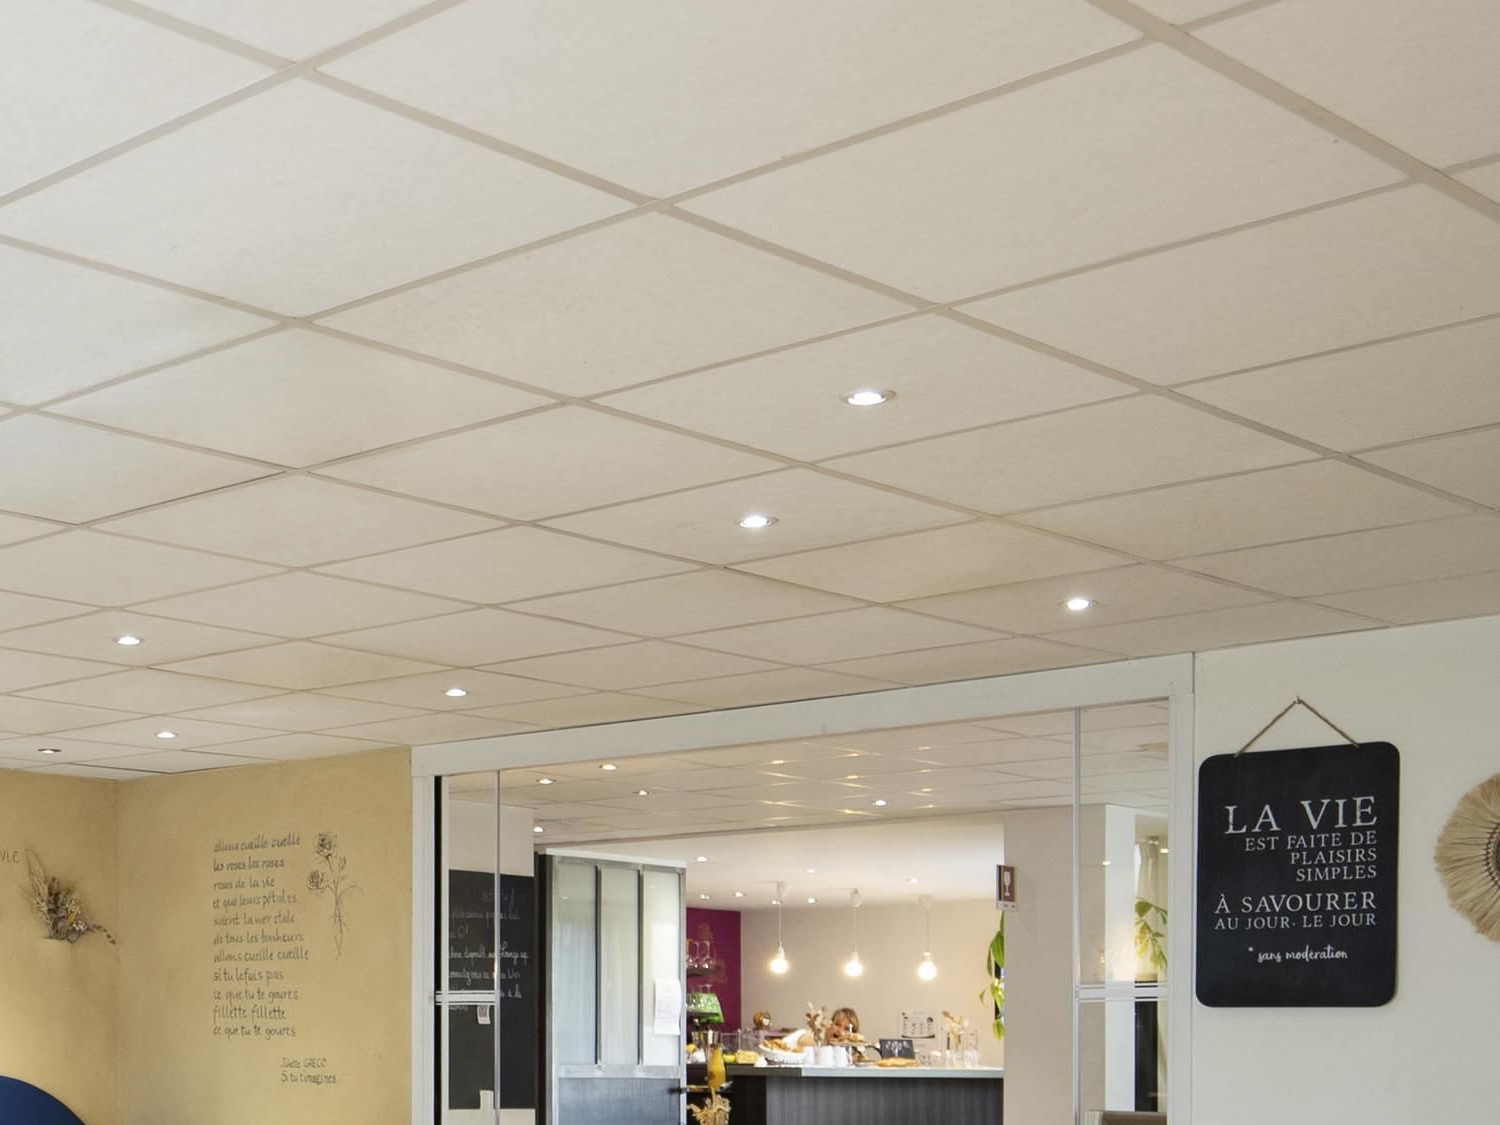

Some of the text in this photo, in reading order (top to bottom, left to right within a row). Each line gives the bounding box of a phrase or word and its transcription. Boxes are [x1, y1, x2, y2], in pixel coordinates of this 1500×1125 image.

[1225, 795, 1378, 834] LA VIE
[1245, 830, 1377, 851] EST FAITE DE
[1, 850, 21, 863] vie
[1290, 847, 1377, 864] PLAISIRS
[227, 861, 246, 872] roses
[262, 858, 284, 869] roses
[1296, 865, 1377, 882] SIMPLES
[235, 878, 245, 889] de
[249, 875, 259, 888] la
[262, 876, 276, 888] vie
[212, 897, 220, 909] et
[223, 898, 237, 913] que
[1214, 890, 1377, 914] À SAVOURER
[1214, 917, 1239, 930] AU
[1302, 915, 1323, 928] LE
[1329, 912, 1376, 927] JOUR
[213, 932, 223, 945] de
[247, 931, 259, 944] les
[213, 967, 221, 982] si
[224, 967, 234, 982] tu
[236, 967, 244, 982] le
[266, 971, 284, 985] pas
[226, 991, 242, 1008] que
[244, 988, 254, 1001] tu
[257, 987, 264, 1001] te
[213, 1004, 287, 1025] fillette fillette
[224, 1027, 238, 1041] que
[241, 1025, 251, 1037] tu
[254, 1025, 261, 1037] te
